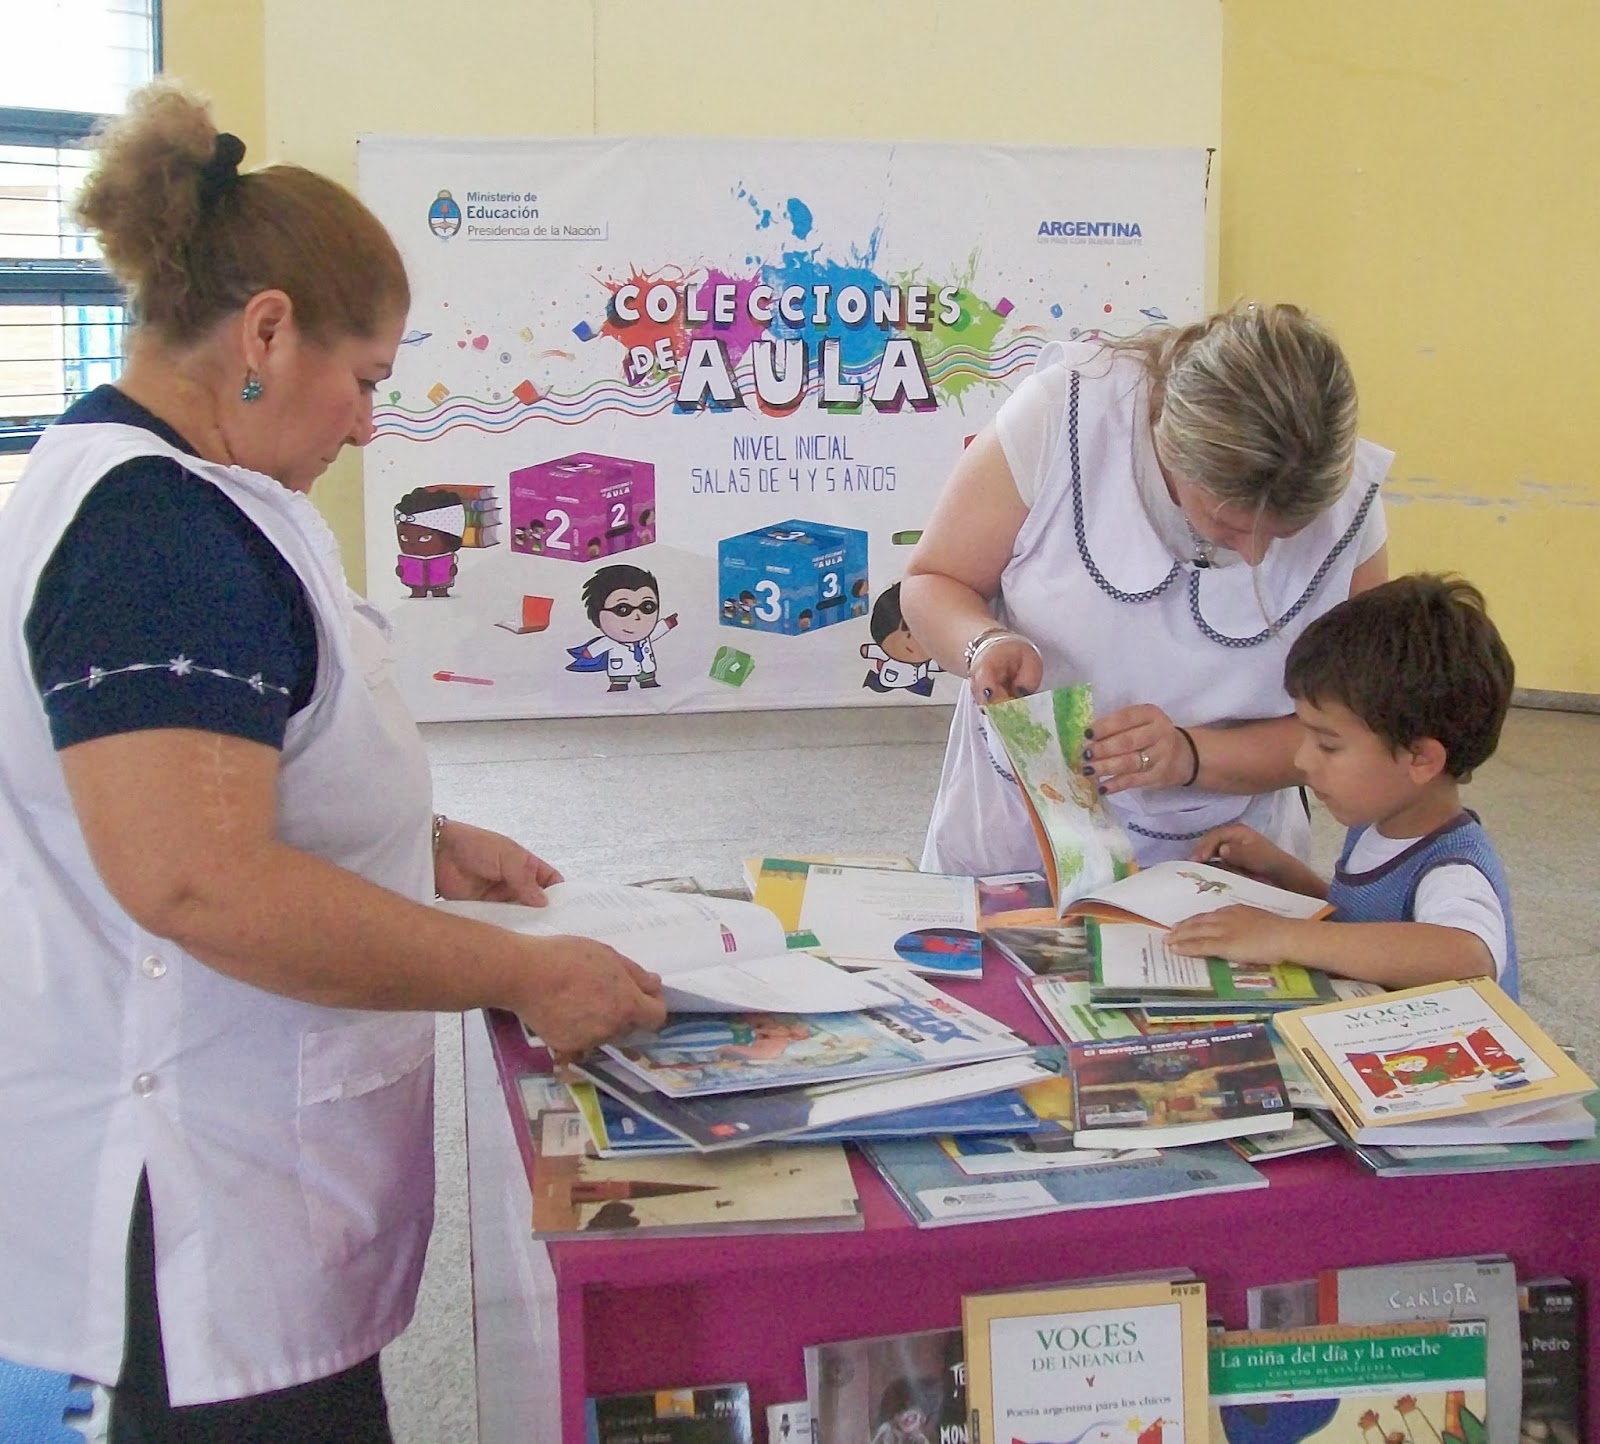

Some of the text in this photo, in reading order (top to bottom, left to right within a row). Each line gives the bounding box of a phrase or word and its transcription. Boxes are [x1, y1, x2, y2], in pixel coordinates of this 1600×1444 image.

[467, 192, 538, 202] Ministerio de
[467, 205, 539, 219] Educación
[467, 225, 601, 236] Presidencia de la Nación
[1037, 221, 1142, 237] ARGENTINA
[614, 285, 962, 326] COLECCIONES
[628, 337, 936, 409] DE AULA
[733, 435, 854, 461] NIVEL INICIAL
[691, 464, 896, 493] SALAS DE 4 Y 5 AÑOS
[611, 503, 626, 528] 2
[545, 509, 571, 550] 2
[823, 572, 838, 598] 3
[755, 580, 782, 622] 3
[1345, 999, 1438, 1022] VOCES
[1036, 1321, 1138, 1351] VOCES
[1532, 1337, 1571, 1352] Pedro
[1032, 1350, 1145, 1371] DE INFANCIA
[1220, 1339, 1441, 1369] La niña del día y la noche
[1006, 1395, 1171, 1418] Poesía argentina para los chicos
